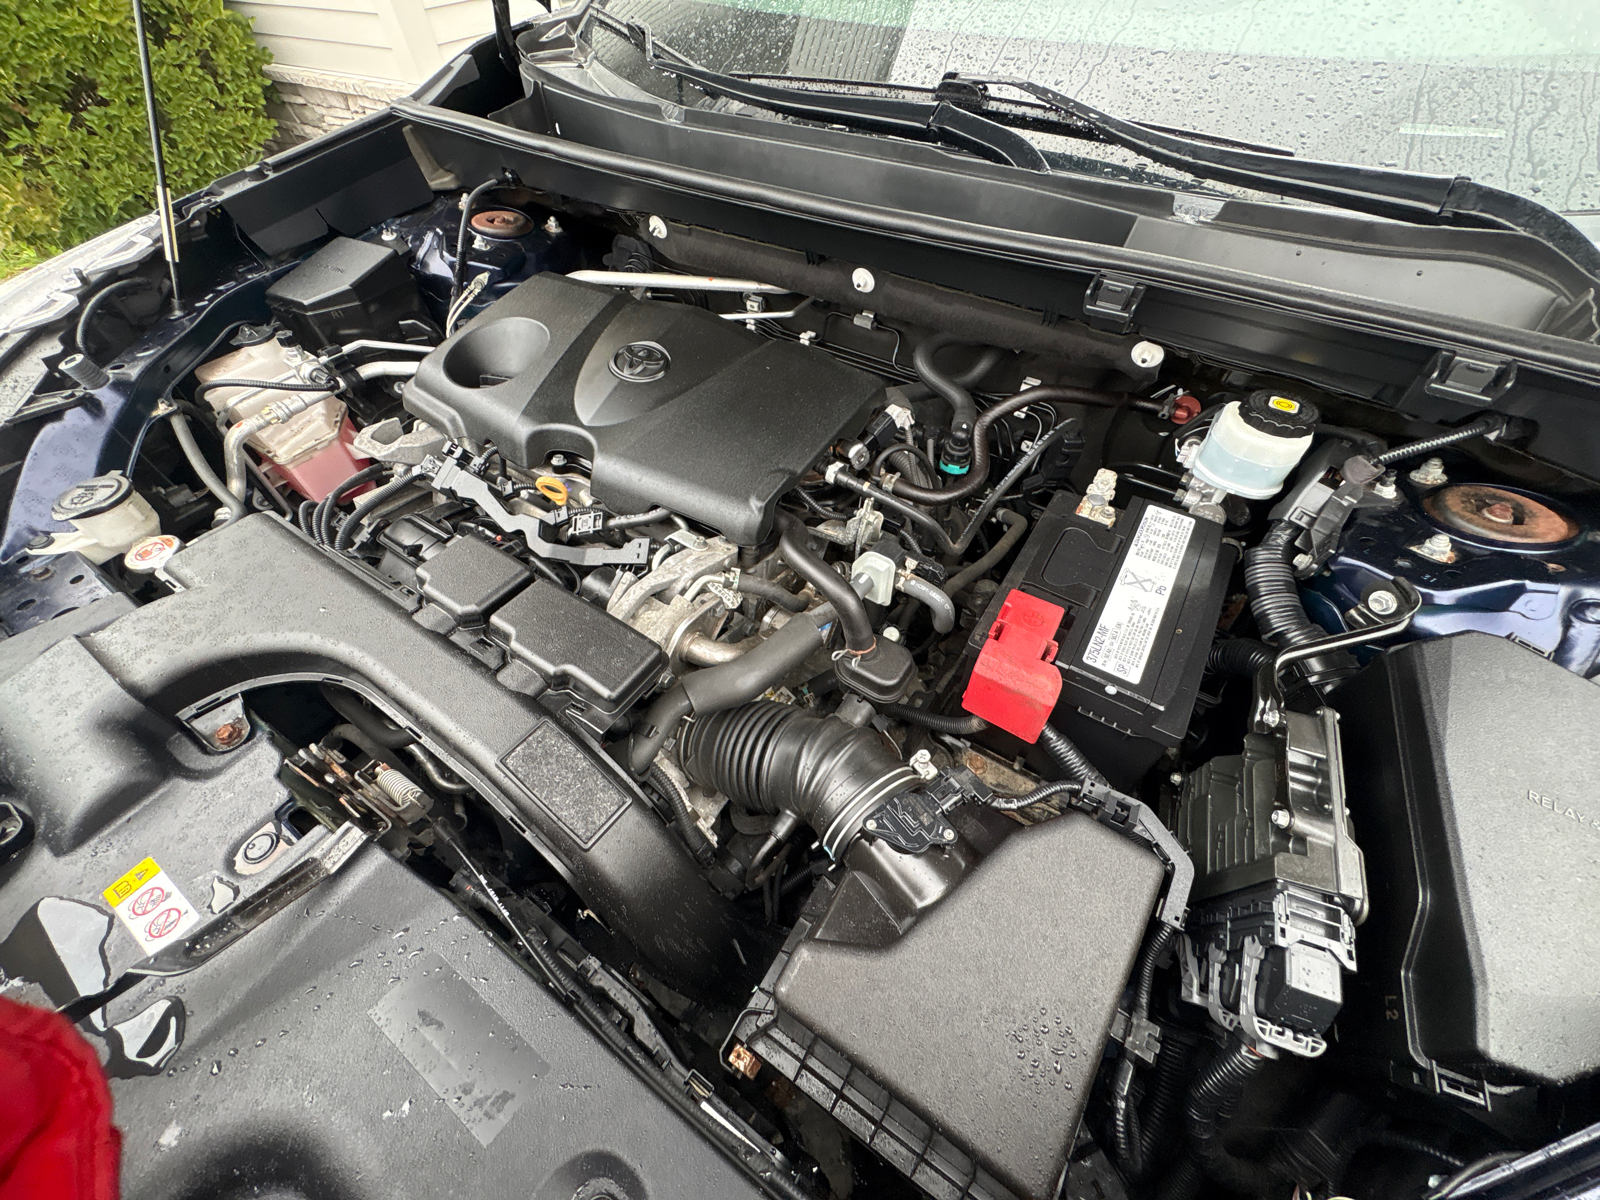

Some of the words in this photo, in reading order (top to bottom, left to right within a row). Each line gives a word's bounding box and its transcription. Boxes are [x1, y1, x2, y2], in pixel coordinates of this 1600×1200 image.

[330, 310, 345, 319] R1
[1155, 585, 1167, 596] Pb
[1085, 623, 1110, 664] 375LN2-MF
[1116, 663, 1128, 675] SP
[1527, 789, 1587, 824] RELAY
[1384, 995, 1399, 1021] L2
